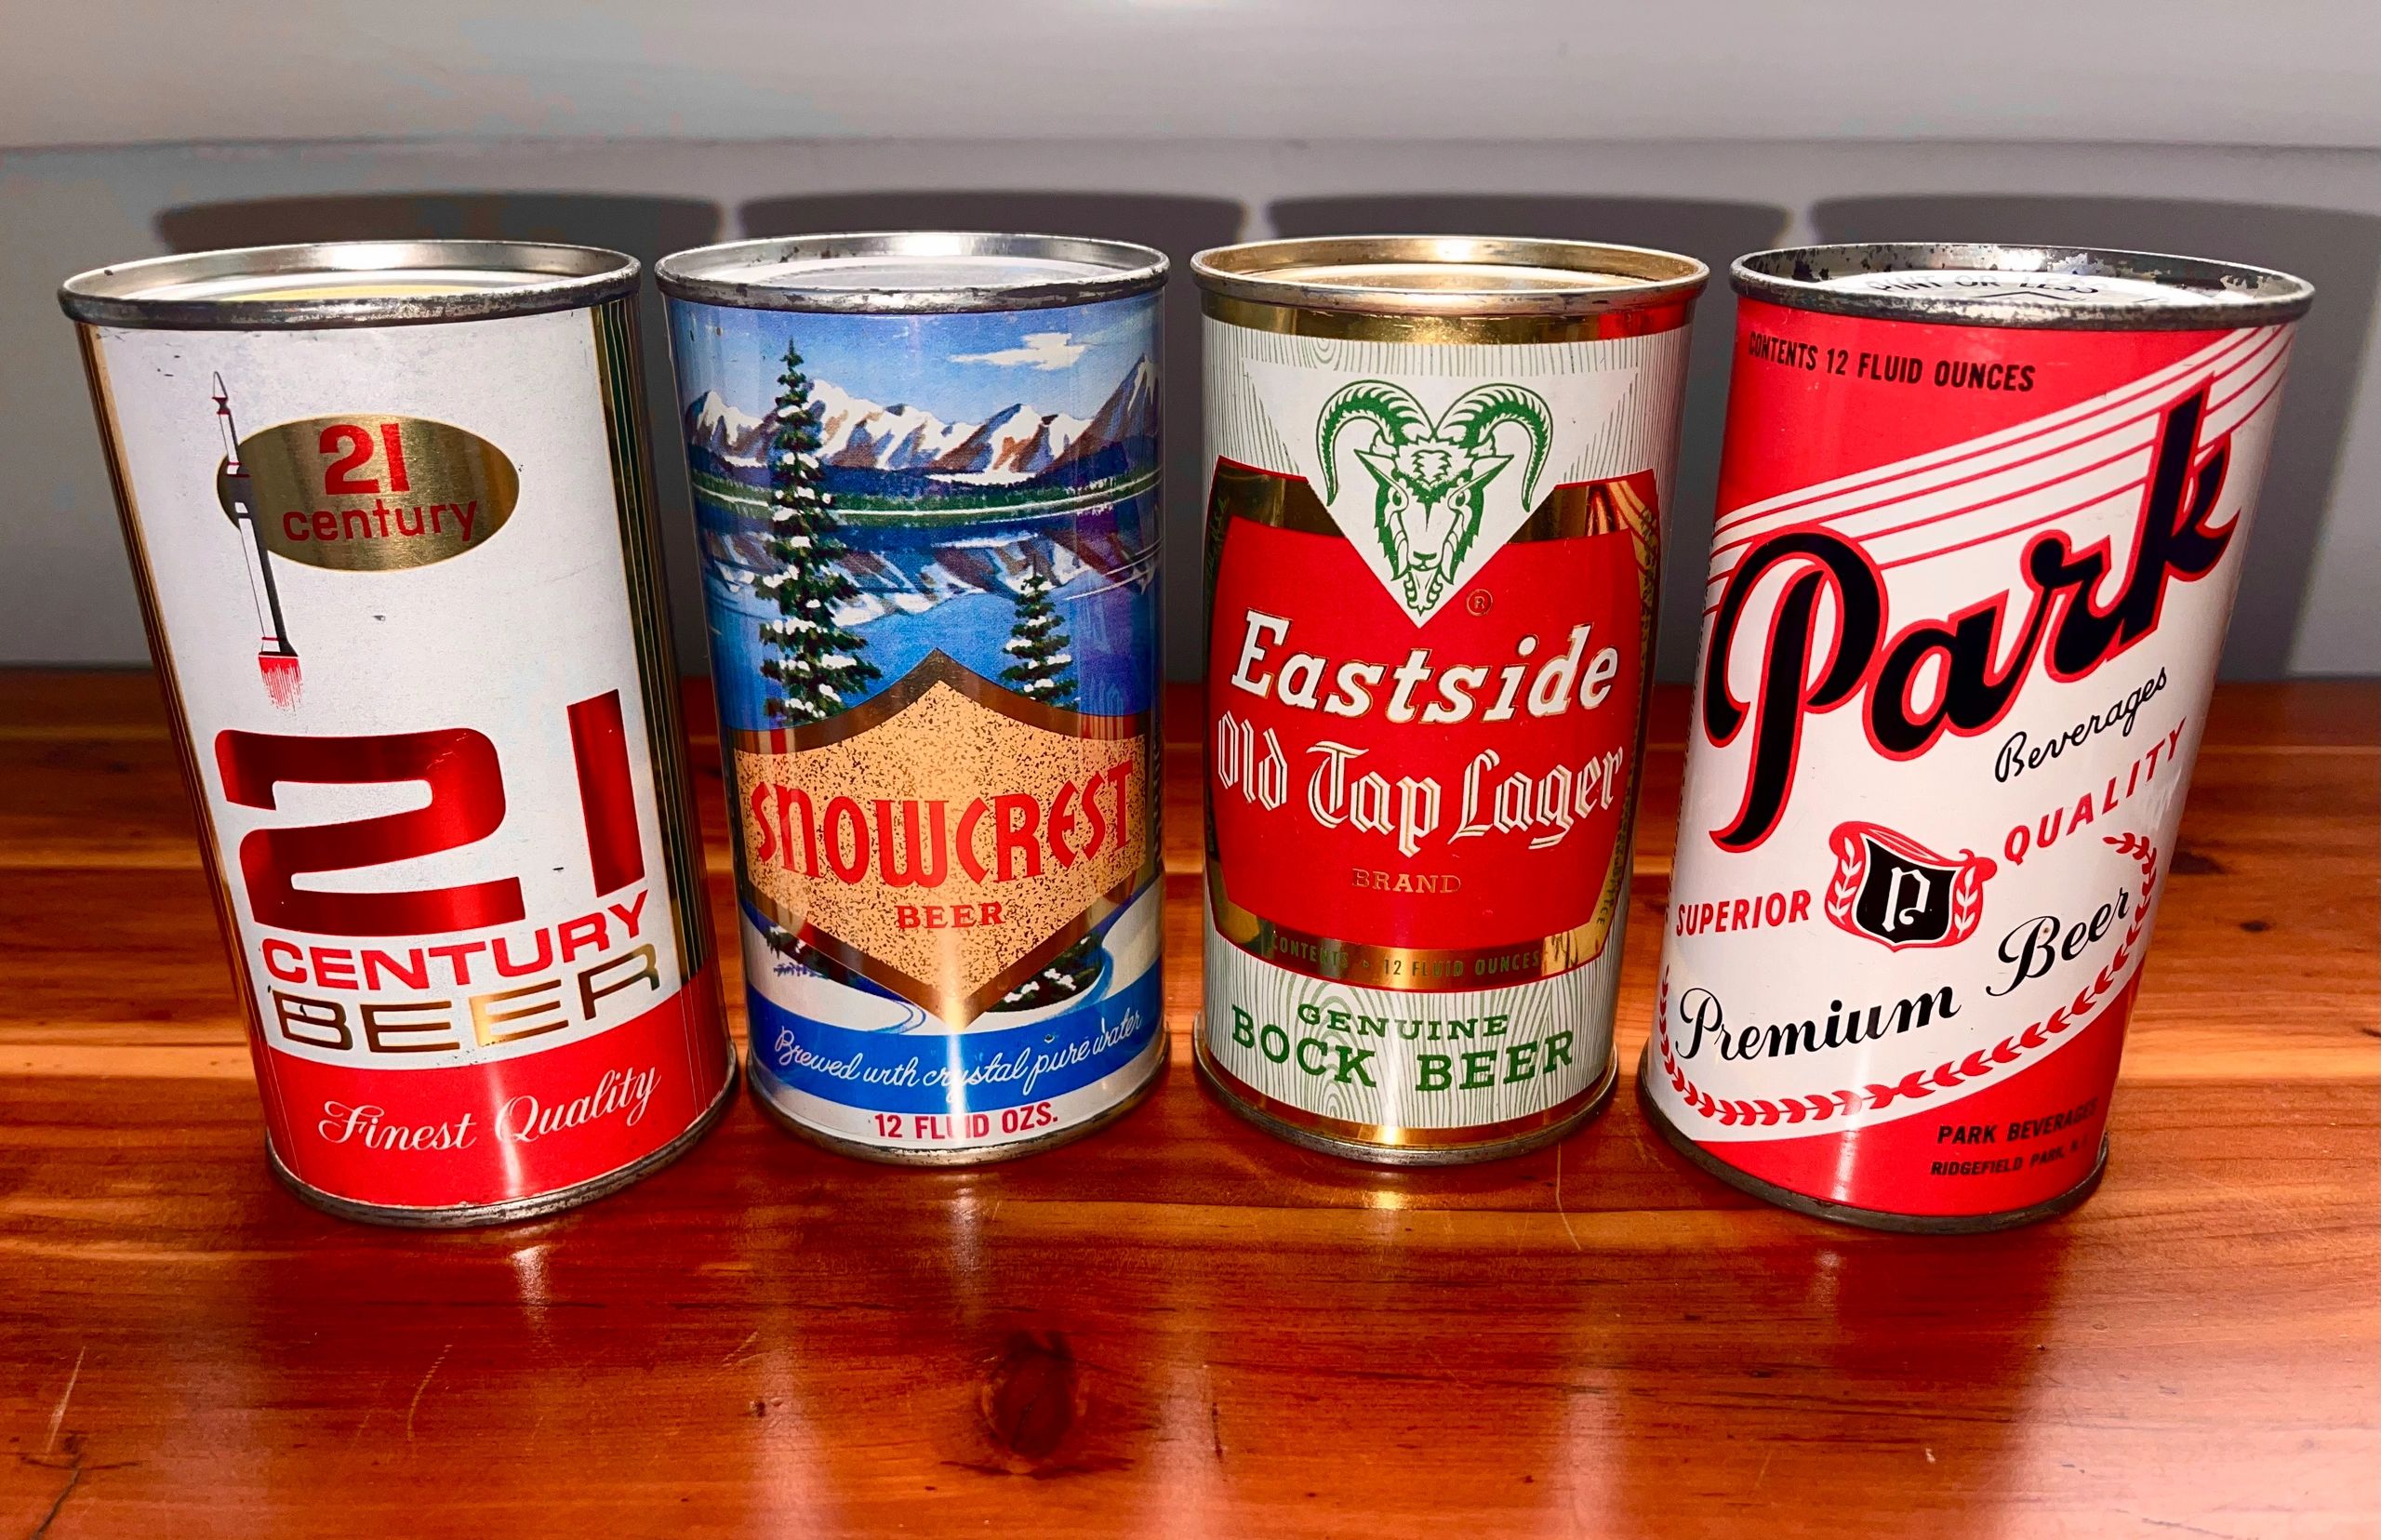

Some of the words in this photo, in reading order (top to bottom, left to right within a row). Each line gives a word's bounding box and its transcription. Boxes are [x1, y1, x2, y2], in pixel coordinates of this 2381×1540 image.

[1749, 331, 1817, 371] CONTENTS
[1827, 348, 1848, 377] 12
[1858, 352, 1922, 385] FLUID
[1934, 360, 2035, 392] OUNCES
[318, 423, 410, 495] 21
[283, 499, 478, 542] century
[1703, 371, 2240, 853] Park
[1230, 606, 1618, 724] Eastside
[1995, 667, 2167, 782] Beverages
[214, 689, 645, 936] 21
[751, 761, 1133, 888] SNOWCREST
[1217, 710, 1289, 811] Old
[1306, 741, 1442, 856] Tap
[1448, 746, 1624, 850] Lager
[1675, 889, 1811, 936] SUPERIOR
[2004, 717, 2187, 865] QUALITY
[895, 902, 1004, 929] BEER
[1351, 869, 1461, 894] BRAND
[261, 889, 648, 989] CENTURY
[1271, 933, 1348, 968] CONTENTS
[1383, 960, 1402, 976] 12
[1412, 961, 1464, 976] FLUID
[1475, 949, 1540, 976] OUNCES
[1675, 986, 1962, 1062] Premium
[1986, 887, 2129, 997] Beer
[272, 943, 659, 1053] BEER
[1297, 1003, 1509, 1040] GENUINE
[775, 1026, 861, 1082] Brewed
[863, 1056, 920, 1087] with
[923, 1047, 1027, 1103] crystal
[1023, 1040, 1091, 1095] pure
[1093, 1007, 1142, 1054] water
[1231, 1006, 1377, 1089] BOCK
[1416, 1030, 1574, 1092] BEER
[318, 1100, 475, 1150] Finest
[495, 1065, 660, 1141] Quality
[874, 1113, 902, 1138] 12
[1002, 1102, 1057, 1134] OZS.
[1937, 1124, 1998, 1144] PARK
[1931, 1156, 2023, 1175] RIDGEFIELD
